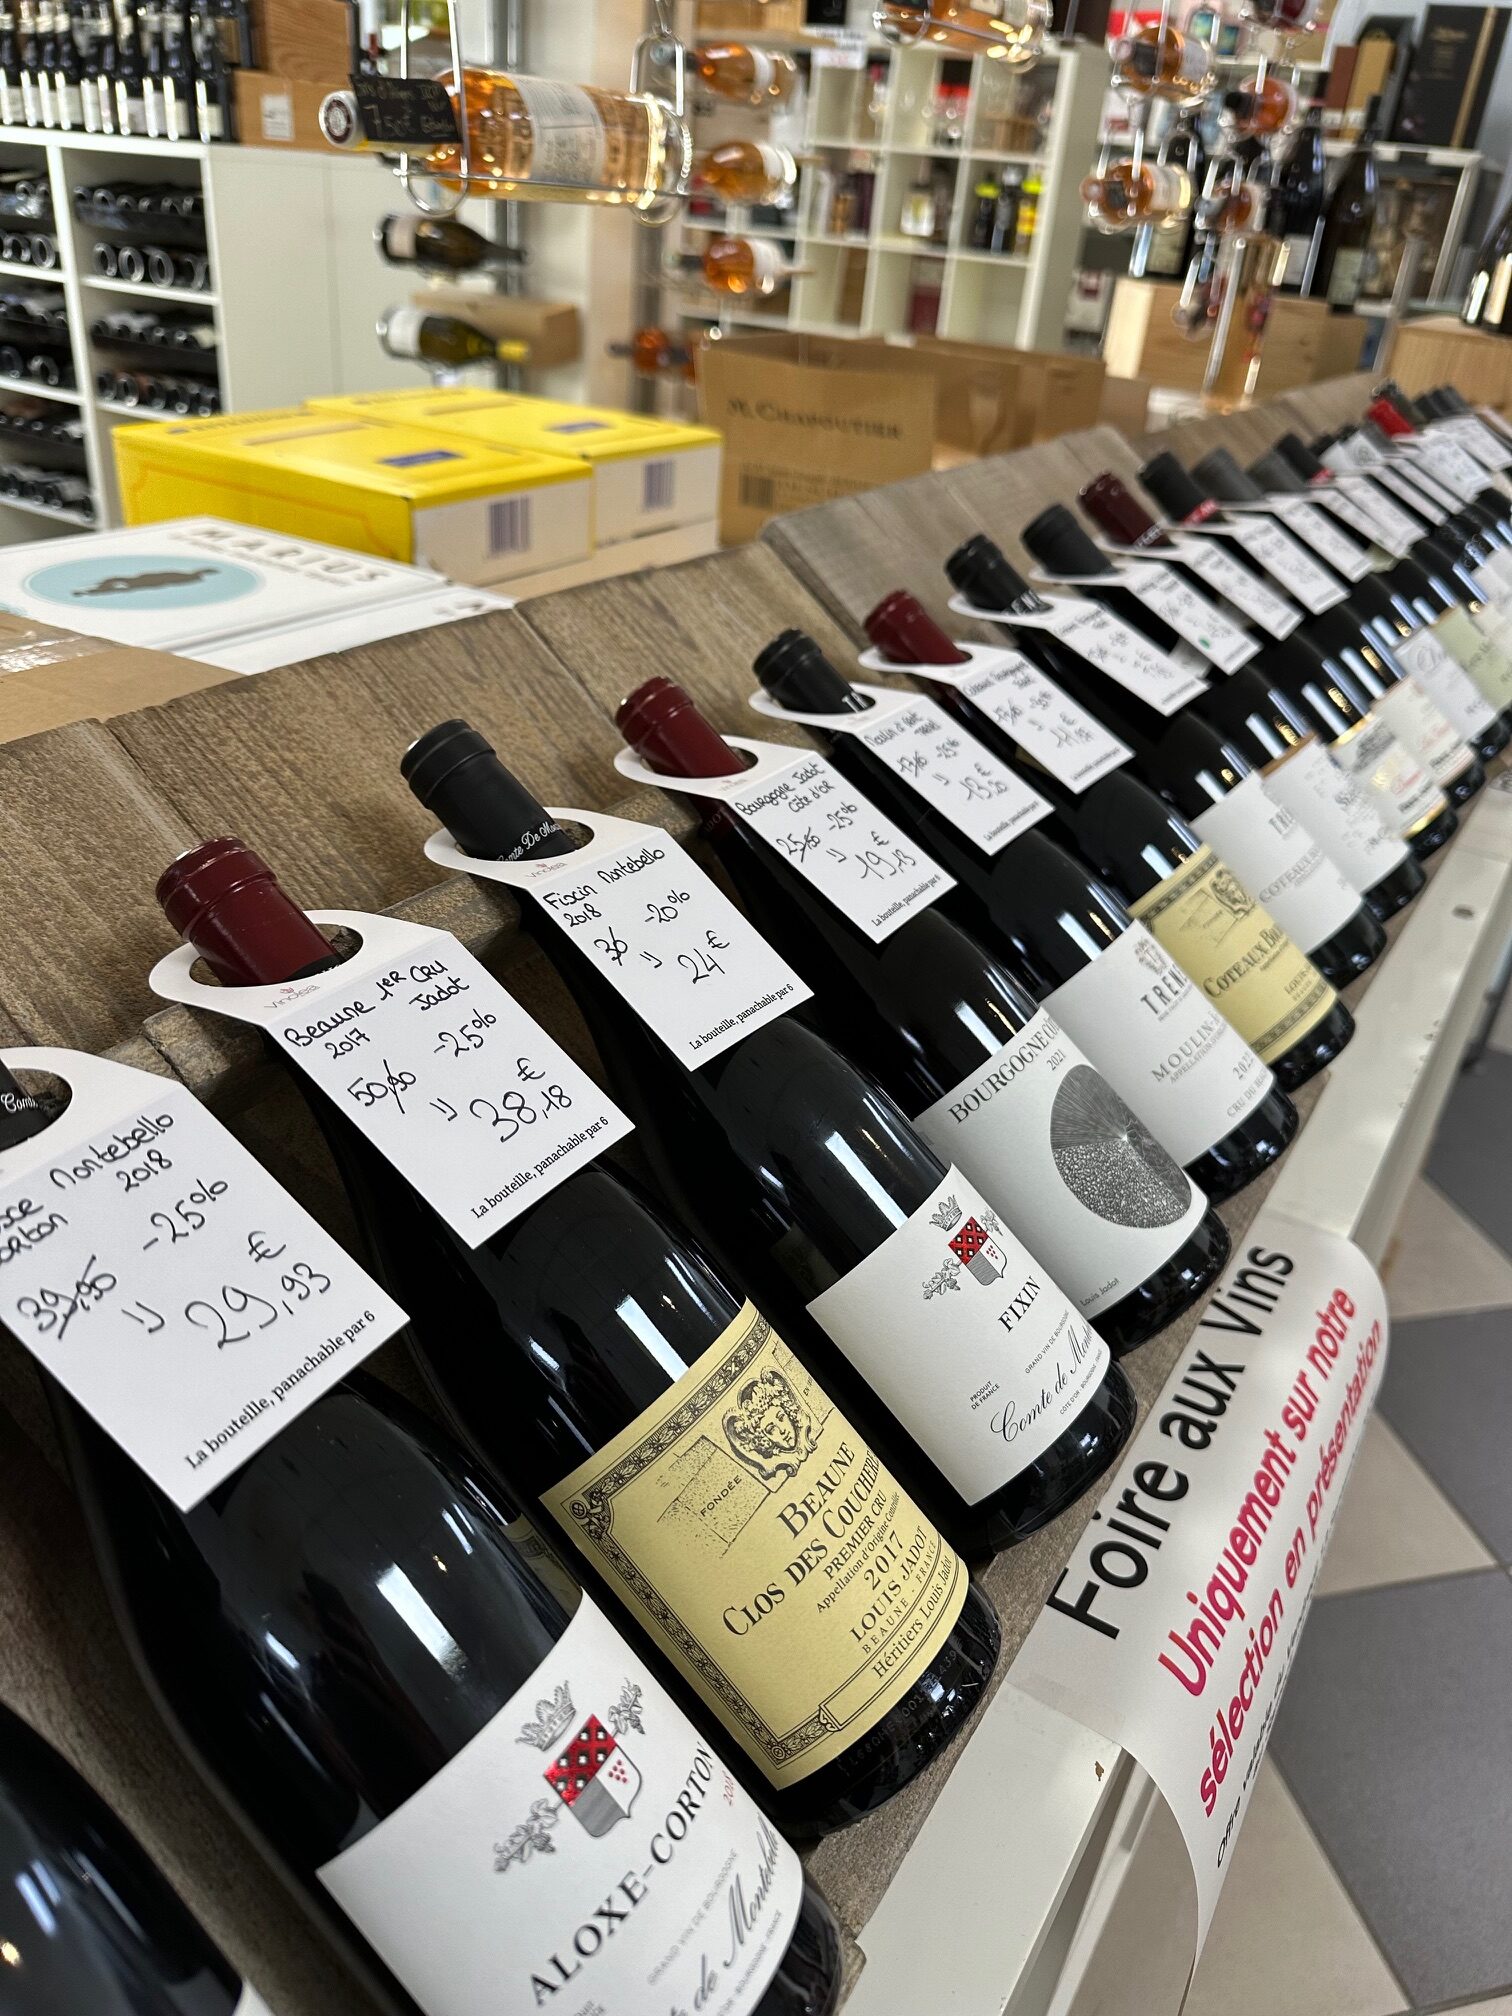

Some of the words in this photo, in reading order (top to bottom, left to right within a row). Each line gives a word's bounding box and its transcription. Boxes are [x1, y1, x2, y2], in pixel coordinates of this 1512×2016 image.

[521, 831, 540, 850] De
[828, 802, 858, 833] -25%
[597, 847, 666, 885] Montebello
[563, 903, 602, 927] 2018
[644, 889, 691, 924] -20%
[677, 949, 727, 984] 24
[706, 930, 730, 950] €
[1203, 941, 1268, 998] COTEAUX
[284, 1000, 376, 1048] Beaune
[409, 977, 470, 1012] Jadot
[688, 1037, 703, 1050] La
[700, 1018, 740, 1043] bouteille,
[736, 994, 778, 1027] panachable
[775, 988, 790, 1002] par
[786, 983, 794, 992] 6
[325, 1028, 371, 1059] 2017
[433, 1007, 497, 1057] -25%
[1047, 1049, 1066, 1071] 2021
[516, 1058, 546, 1081] €
[947, 1032, 1049, 1124] BOURGOGNE
[469, 1085, 572, 1143] 38,18
[49, 1114, 174, 1189] Montebello
[115, 1149, 172, 1192] 2018
[471, 1204, 490, 1220] La
[486, 1167, 538, 1212] bouteille,
[534, 1128, 590, 1179] panachable
[585, 1122, 604, 1142] par
[600, 1115, 610, 1126] 6
[143, 1178, 228, 1250] -25%
[247, 1231, 287, 1264] €
[185, 1261, 331, 1349] 29,93
[998, 1275, 1041, 1332] FIXIN
[1079, 1289, 1099, 1307] Louis
[1198, 1245, 1295, 1337] Vins
[1025, 1353, 1043, 1374] GRAND
[1041, 1343, 1051, 1356] VIN
[1048, 1335, 1056, 1345] DE
[184, 1449, 209, 1470] La
[206, 1392, 276, 1453] bouteille,
[273, 1336, 346, 1401] panachable
[342, 1320, 367, 1346] par
[363, 1309, 376, 1323] 6
[970, 1380, 992, 1402] PRODUIT
[971, 1397, 982, 1410] DE
[978, 1383, 1000, 1404] FRANCE
[990, 1388, 1053, 1442] Comte
[1055, 1362, 1067, 1394] de
[1159, 1350, 1246, 1450] aux
[700, 1474, 743, 1517] FONDÉE
[776, 1440, 856, 1538] BEAUNE
[1158, 1428, 1298, 1697] Uniquement
[1281, 1369, 1316, 1441] sur
[1306, 1286, 1357, 1382] notre
[816, 1556, 864, 1614] Appellation
[861, 1521, 889, 1561] d'Origine
[885, 1491, 900, 1524] Contrôlée
[823, 1516, 875, 1581] PREMIER
[872, 1489, 888, 1517] CRU
[864, 1530, 904, 1591] 2017
[1044, 1459, 1190, 1640] Foire
[722, 1581, 786, 1638] CLOS
[783, 1541, 829, 1587] DES
[849, 1580, 902, 1642] LOUIS
[902, 1525, 928, 1582] JADOT
[862, 1596, 909, 1654] BEAUNE
[915, 1540, 936, 1585] FRANCE
[1200, 1587, 1284, 1818] sélection
[1285, 1526, 1307, 1589] en
[1305, 1319, 1383, 1541] présentation
[872, 1618, 924, 1679] Héritiers
[919, 1583, 944, 1620] Louis
[938, 1555, 953, 1586] Jadot
[529, 1741, 714, 2007] ALOXE-CORTON
[694, 1953, 719, 2012] de
